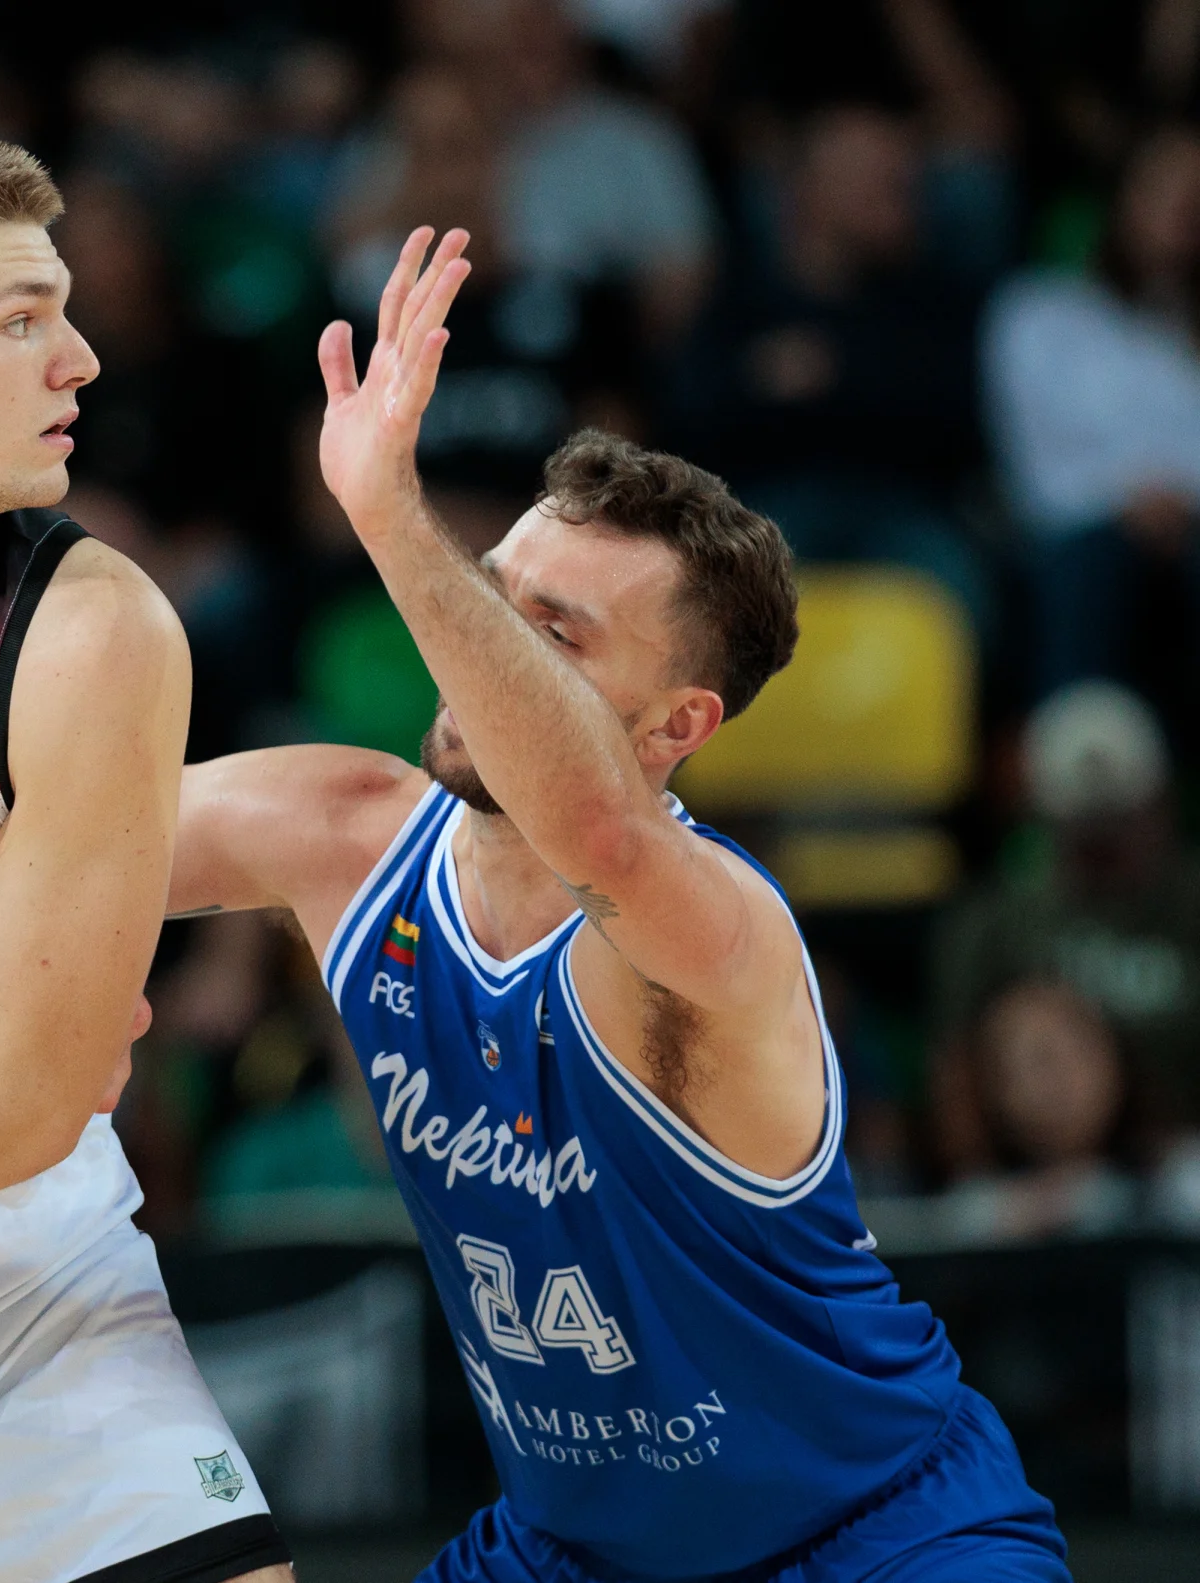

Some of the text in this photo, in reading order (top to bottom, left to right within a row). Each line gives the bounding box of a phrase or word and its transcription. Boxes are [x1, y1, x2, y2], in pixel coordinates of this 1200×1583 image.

[456, 1233, 637, 1375] 24
[532, 1436, 720, 1472] HOTEL GROUP
